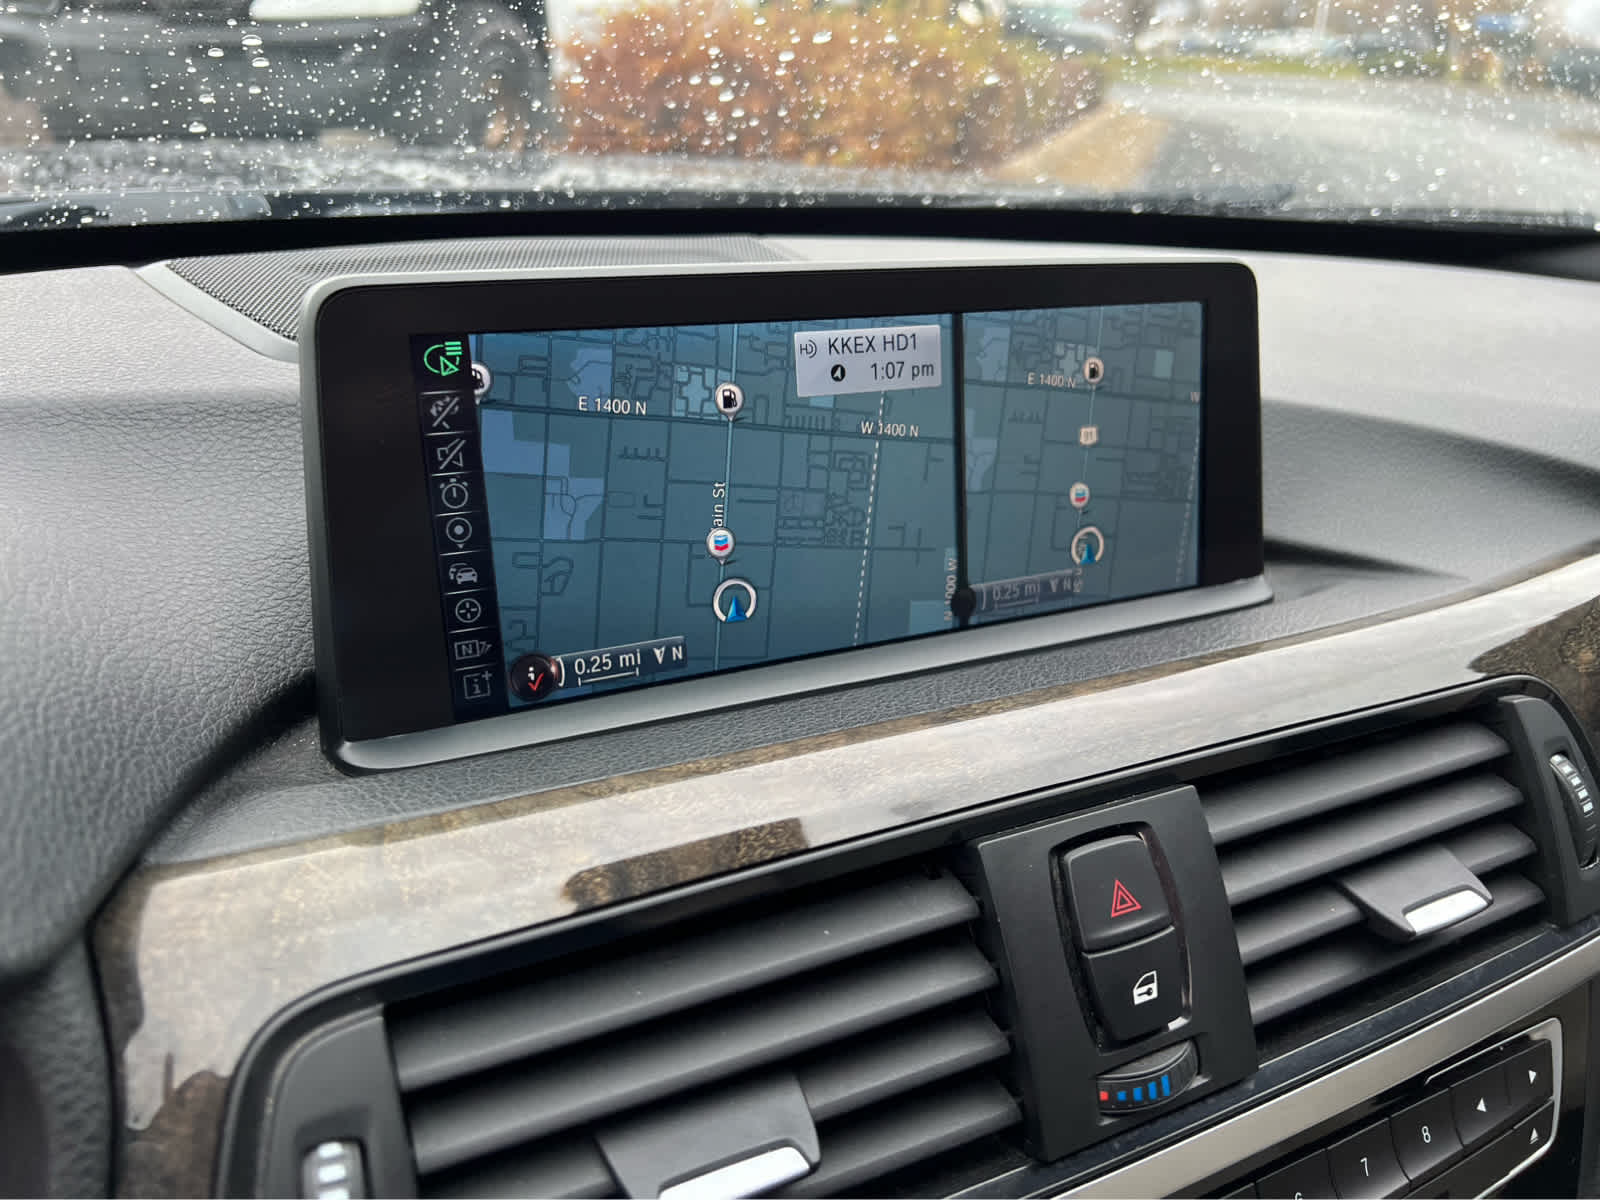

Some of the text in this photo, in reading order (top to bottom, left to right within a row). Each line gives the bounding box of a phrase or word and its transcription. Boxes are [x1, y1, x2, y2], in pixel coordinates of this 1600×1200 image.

[828, 333, 918, 356] KKEX HD1
[870, 361, 935, 382] 1:07 pm
[578, 396, 648, 415] E 1400 N
[860, 421, 874, 434] W
[910, 425, 920, 438] N
[711, 482, 726, 529] ain St
[992, 583, 1021, 601] 0.25
[574, 645, 683, 675] 0.25 mi N
[1420, 1125, 1432, 1144] 8
[1359, 1156, 1370, 1178] 7
